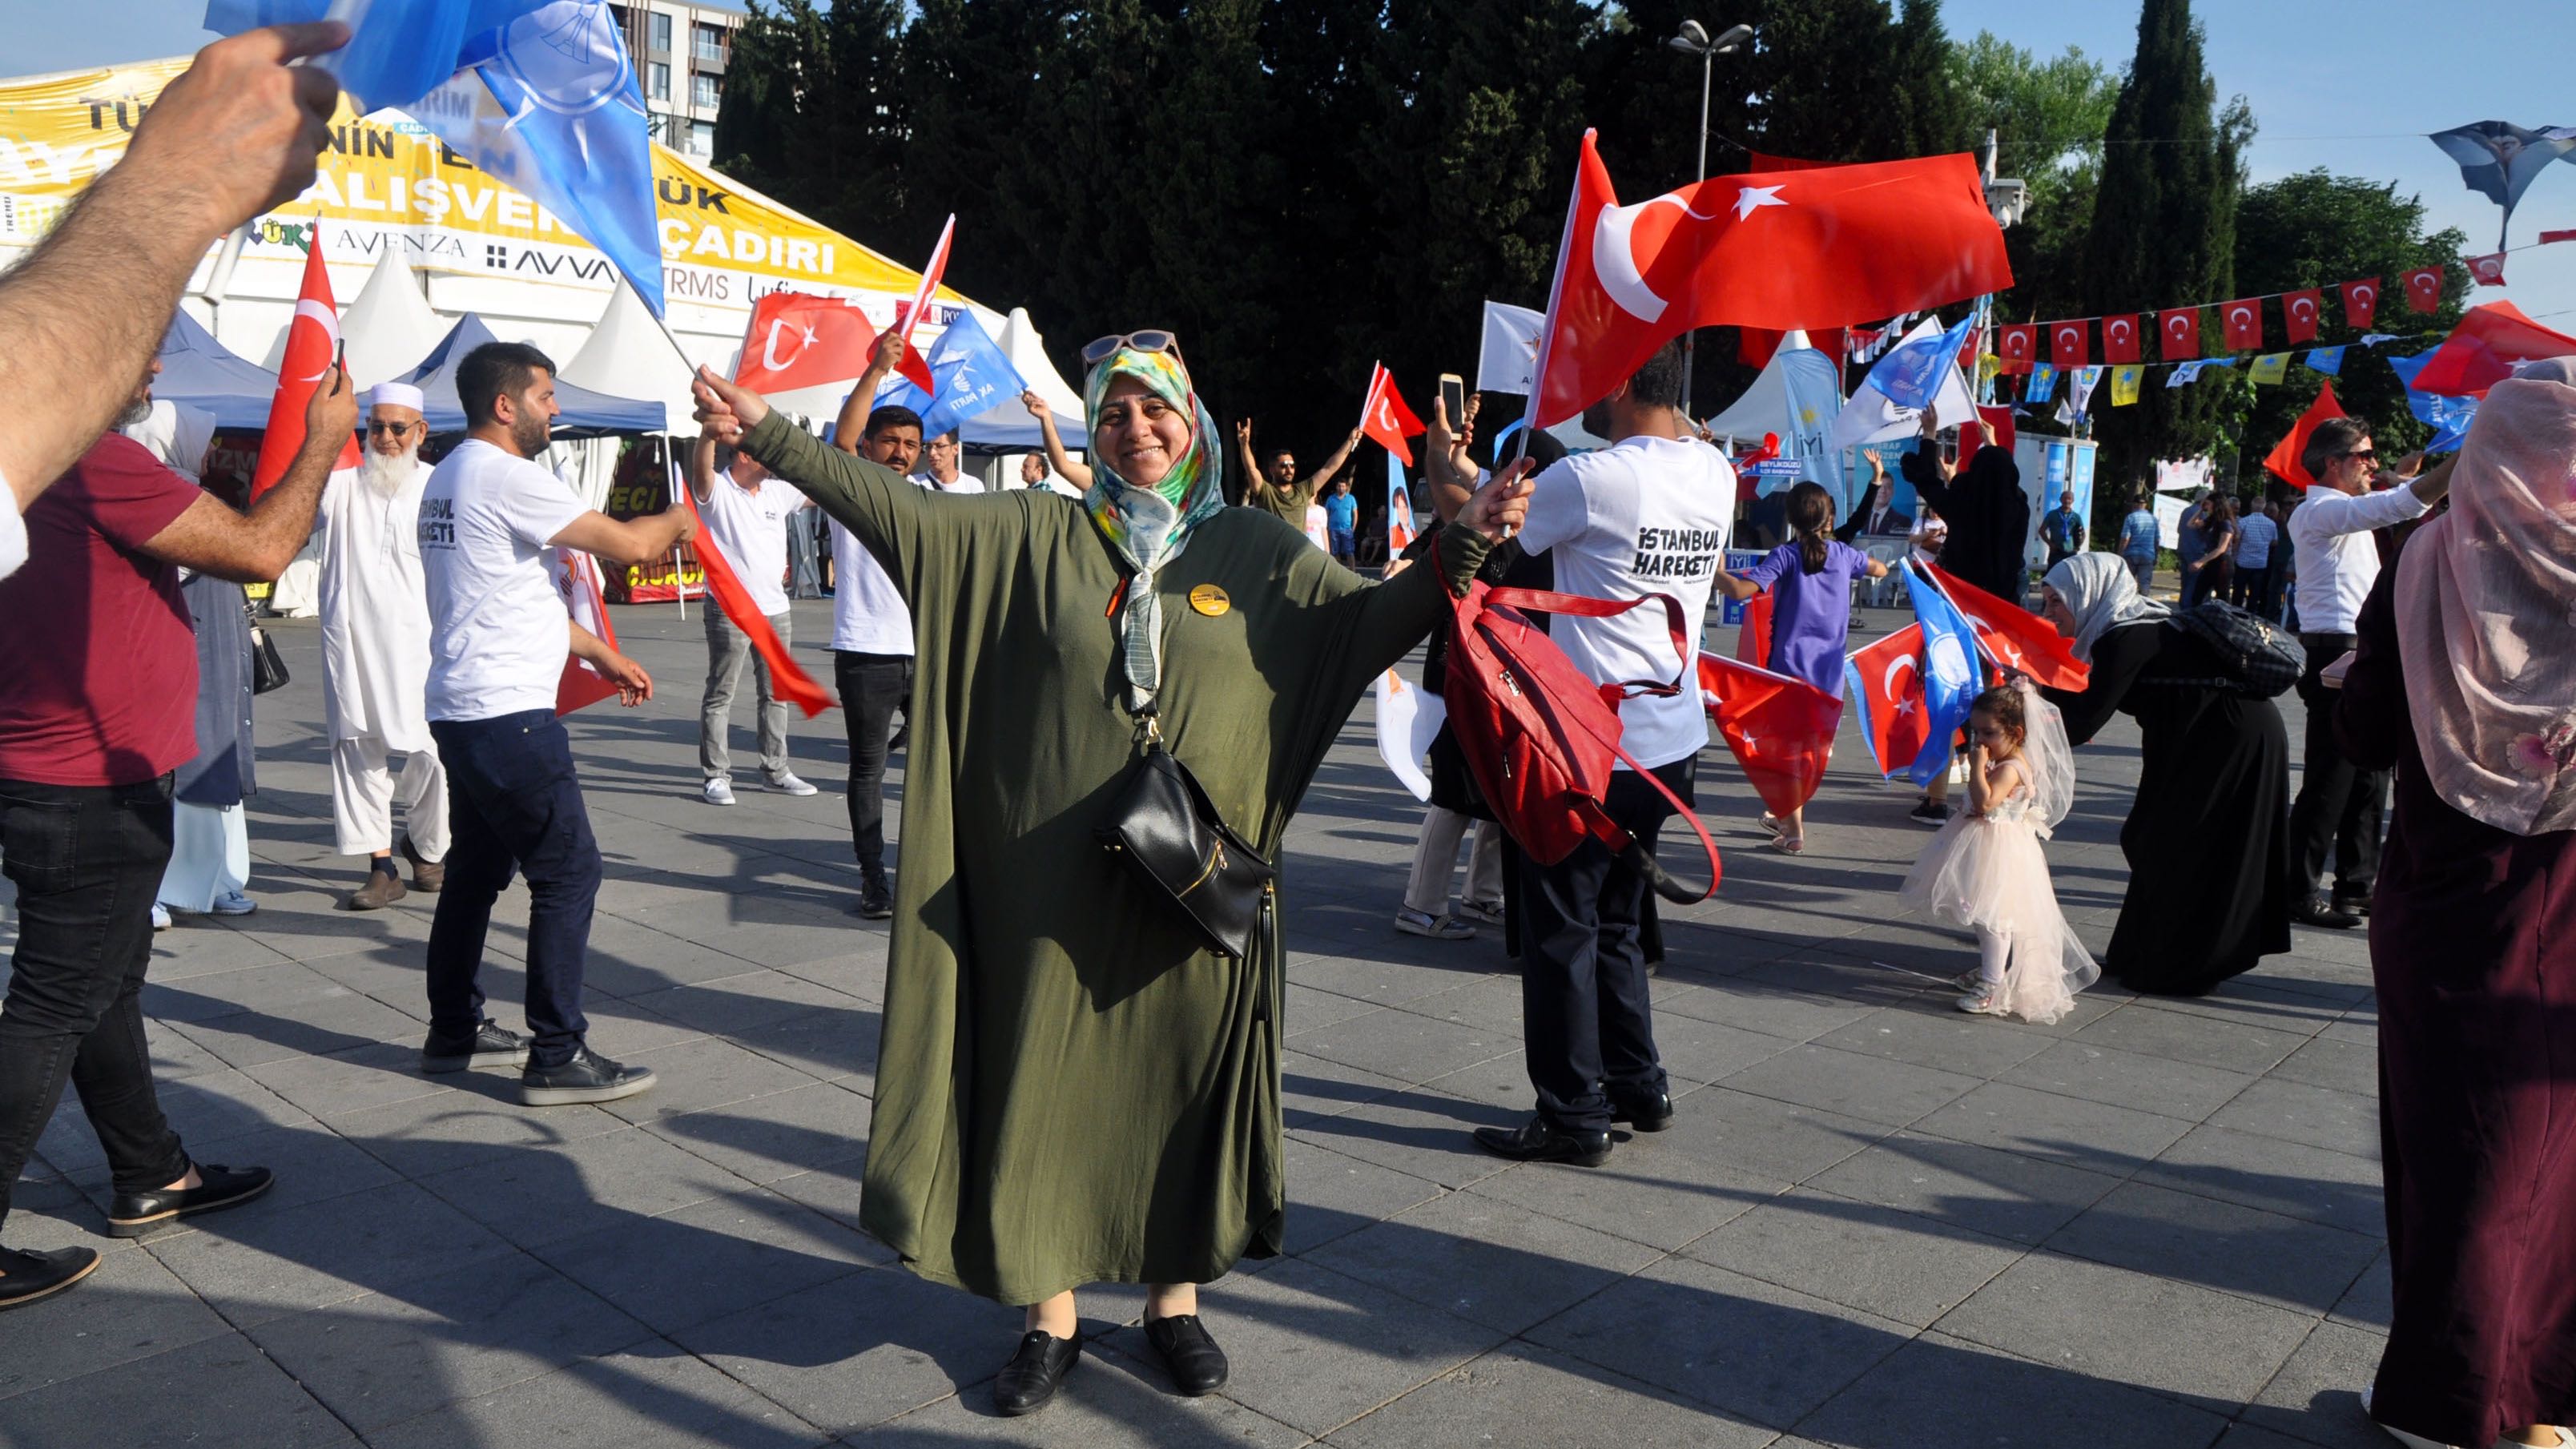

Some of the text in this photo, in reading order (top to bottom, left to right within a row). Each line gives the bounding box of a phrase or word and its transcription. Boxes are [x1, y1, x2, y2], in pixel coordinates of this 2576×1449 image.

[79, 94, 149, 132] TÜ
[324, 119, 394, 159] NİN
[658, 175, 731, 215] ÜK
[294, 168, 834, 276] ALIŞVER ÇADIRI
[336, 229, 465, 258] AVENZA
[515, 250, 616, 284] AVVA
[1799, 432, 1823, 457] İYİ
[611, 481, 659, 512] ECİ
